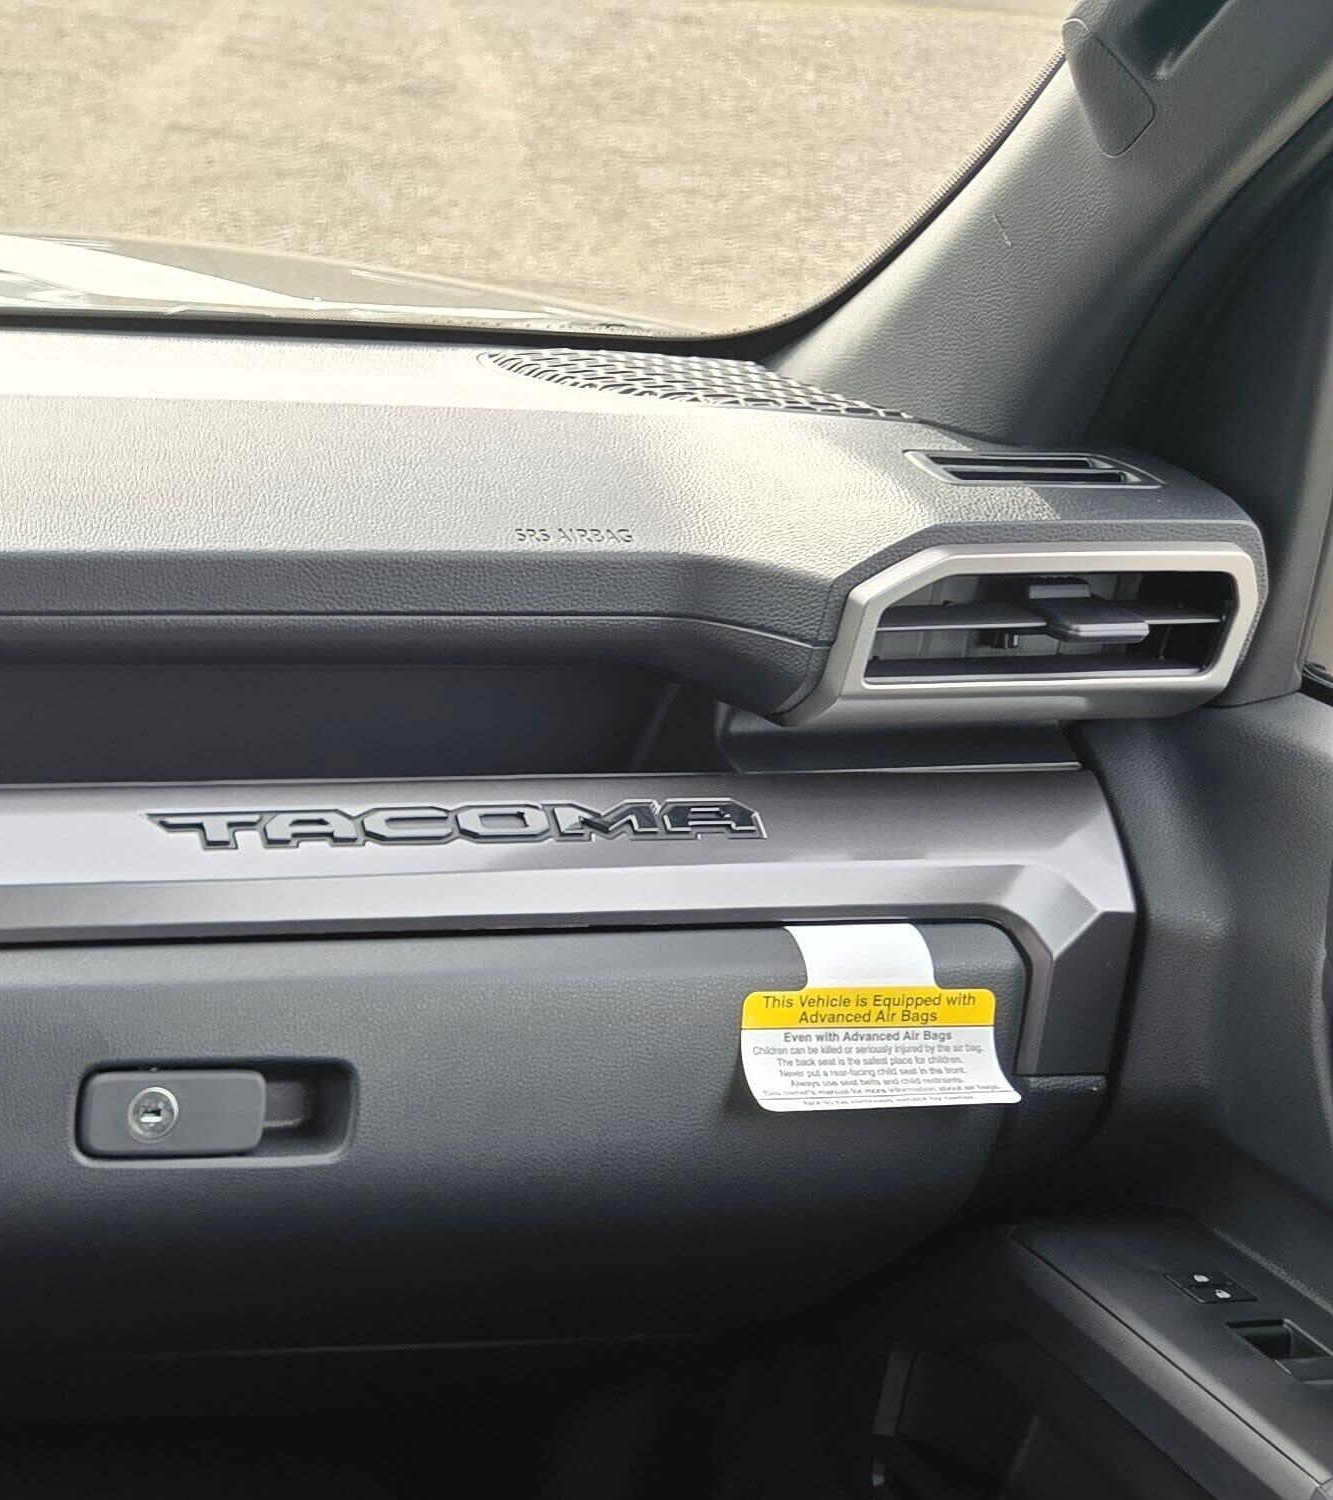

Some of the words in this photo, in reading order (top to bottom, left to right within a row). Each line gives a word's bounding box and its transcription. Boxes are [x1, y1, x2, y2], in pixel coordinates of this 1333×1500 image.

[515, 528, 551, 542] SRS
[558, 528, 633, 543] AIRBAG
[143, 797, 767, 850] TACOMA
[763, 995, 793, 1008] This
[799, 994, 851, 1008] Vehicle
[856, 994, 867, 1007] is
[873, 993, 942, 1009] Equipped
[946, 993, 976, 1006] with
[799, 1010, 872, 1023] Advanced
[876, 1010, 896, 1022] Air
[901, 1010, 938, 1024] Bags
[784, 1032, 812, 1042] Even
[815, 1031, 840, 1042] with
[842, 1031, 900, 1042] Advanced
[903, 1031, 921, 1041] Air
[923, 1031, 952, 1042] Bags
